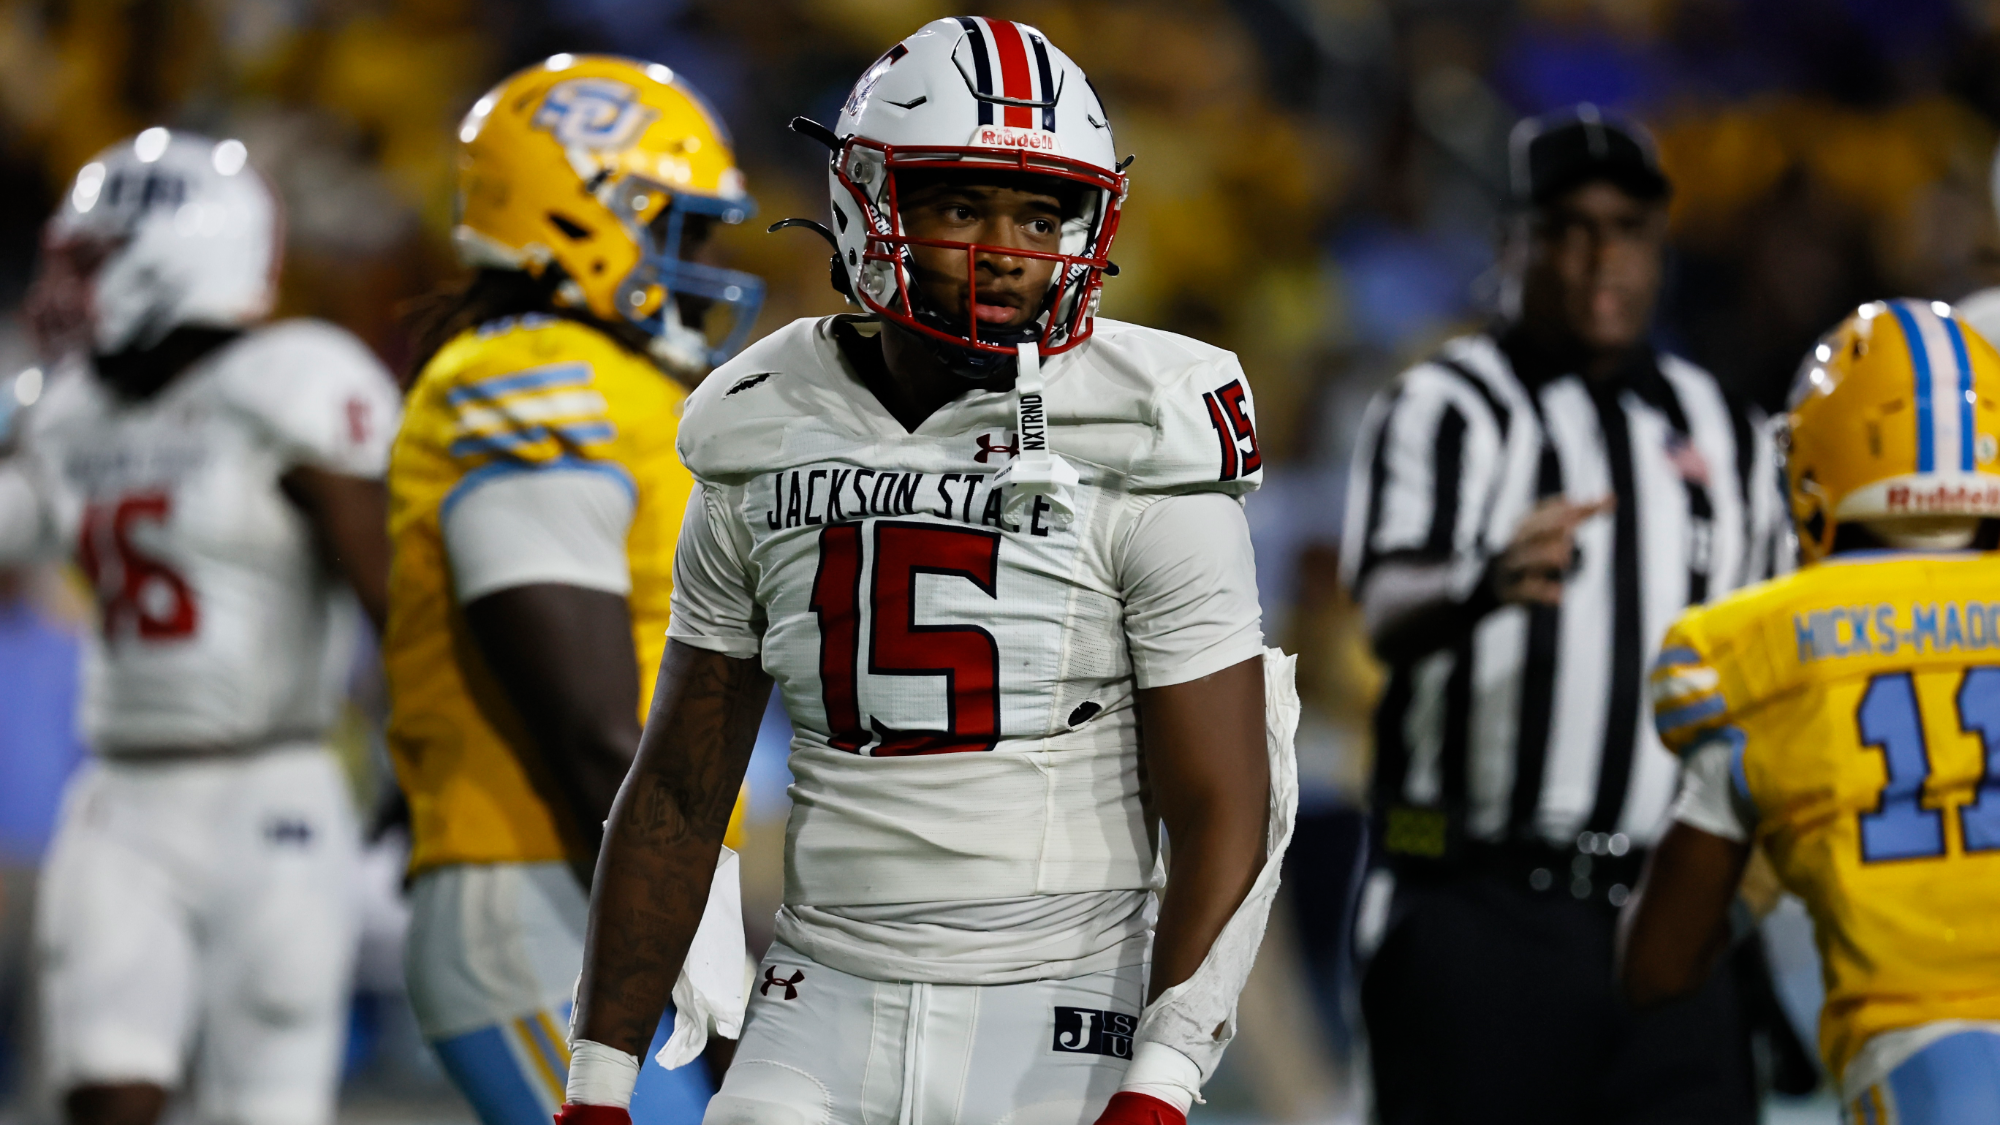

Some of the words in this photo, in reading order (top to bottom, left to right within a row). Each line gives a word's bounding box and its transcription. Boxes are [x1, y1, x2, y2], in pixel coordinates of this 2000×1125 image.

[981, 130, 1053, 150] Riddell
[1020, 394, 1046, 451] NXTRND
[1202, 378, 1262, 482] 15
[767, 468, 923, 531] JACKSON
[933, 473, 1051, 537] STAE
[808, 519, 1002, 758] 15
